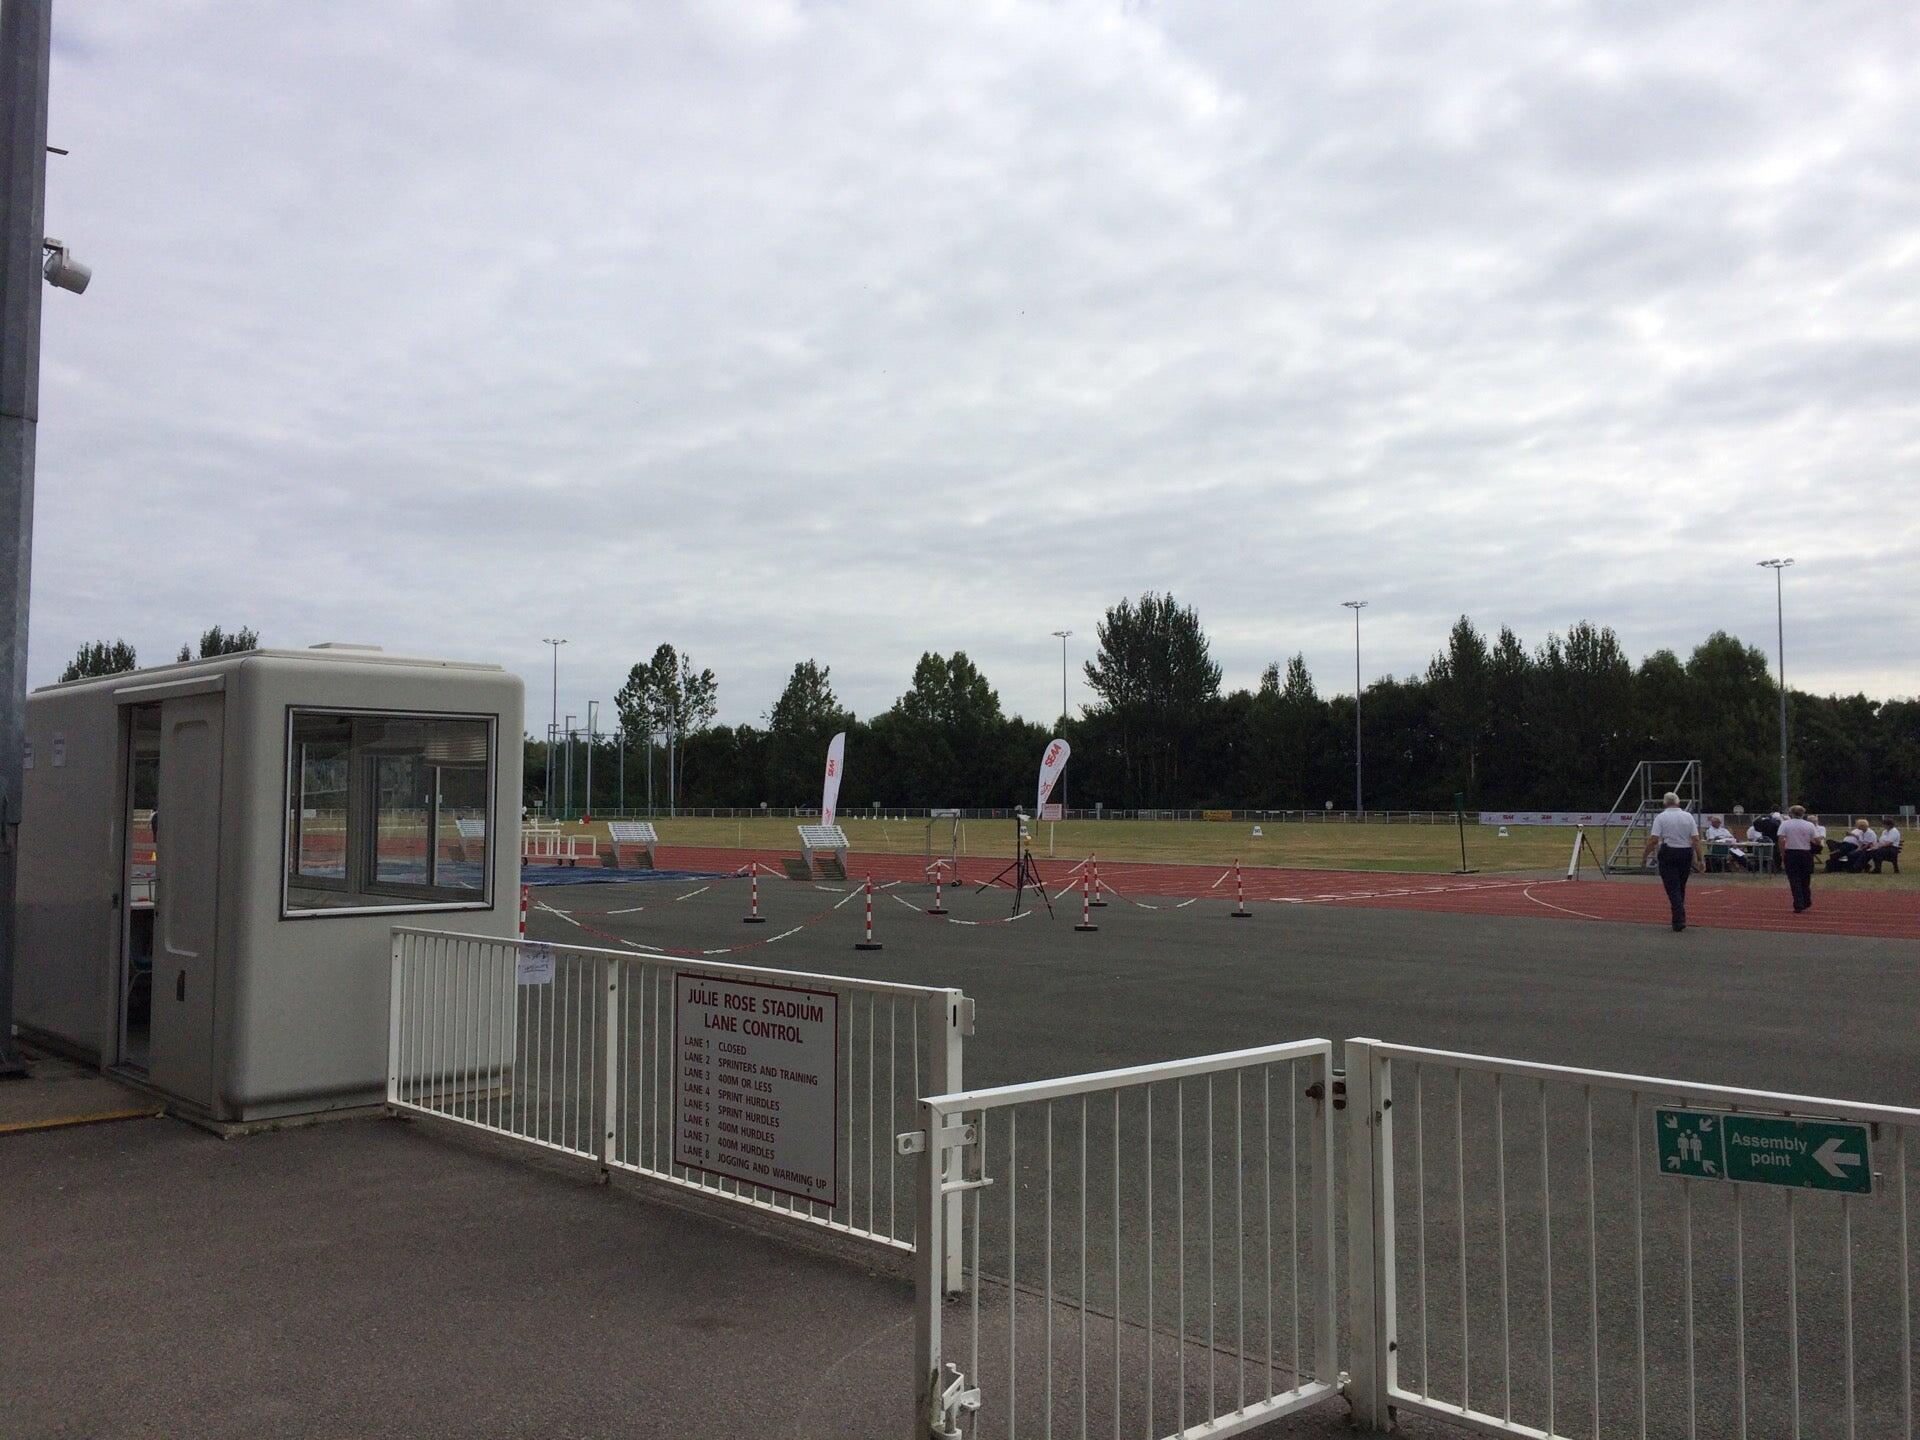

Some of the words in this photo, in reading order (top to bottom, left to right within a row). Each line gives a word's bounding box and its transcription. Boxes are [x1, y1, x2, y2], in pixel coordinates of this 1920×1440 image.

[688, 988, 719, 1007] JULIE
[724, 993, 757, 1013] ROSE
[762, 998, 823, 1023] STADIUM
[704, 1013, 737, 1032] LANE
[742, 1019, 803, 1043] CONTROL
[684, 1036, 703, 1048] LANE
[705, 1040, 710, 1049] 1
[718, 1041, 747, 1056] CLOSED
[684, 1051, 703, 1064] LANE
[705, 1055, 710, 1065] 2
[718, 1057, 757, 1074] SPRINTERS
[760, 1065, 777, 1078] AND
[780, 1069, 818, 1086] TRAINING
[684, 1066, 703, 1080] LANE
[705, 1071, 710, 1080] 3
[718, 1073, 739, 1087] 400M
[741, 1078, 751, 1089] OR
[754, 1080, 773, 1093] LESS
[684, 1082, 703, 1095] LANE
[705, 1086, 710, 1096] 4
[718, 1089, 743, 1104] SPRINT
[745, 1095, 780, 1111] HURDLES
[683, 1113, 703, 1126] LANE
[705, 1118, 710, 1128] 6
[718, 1120, 738, 1134] 400M
[741, 1126, 775, 1143] HURDLES
[684, 1098, 703, 1111] LANE
[705, 1102, 710, 1112] 5
[718, 1105, 743, 1119] SPRINT
[745, 1111, 780, 1128] HURDLES
[683, 1128, 703, 1142] LANE
[704, 1133, 710, 1143] 7
[718, 1136, 738, 1150] 400M
[741, 1142, 775, 1160] HURDLES
[1732, 1132, 1807, 1154] Assembly
[683, 1144, 703, 1158] LANE
[705, 1149, 710, 1159] 8
[718, 1152, 750, 1170] JOGGING
[752, 1162, 770, 1175] AND
[772, 1166, 813, 1187] WARMING
[815, 1178, 827, 1189] UP
[1751, 1152, 1791, 1167] point
